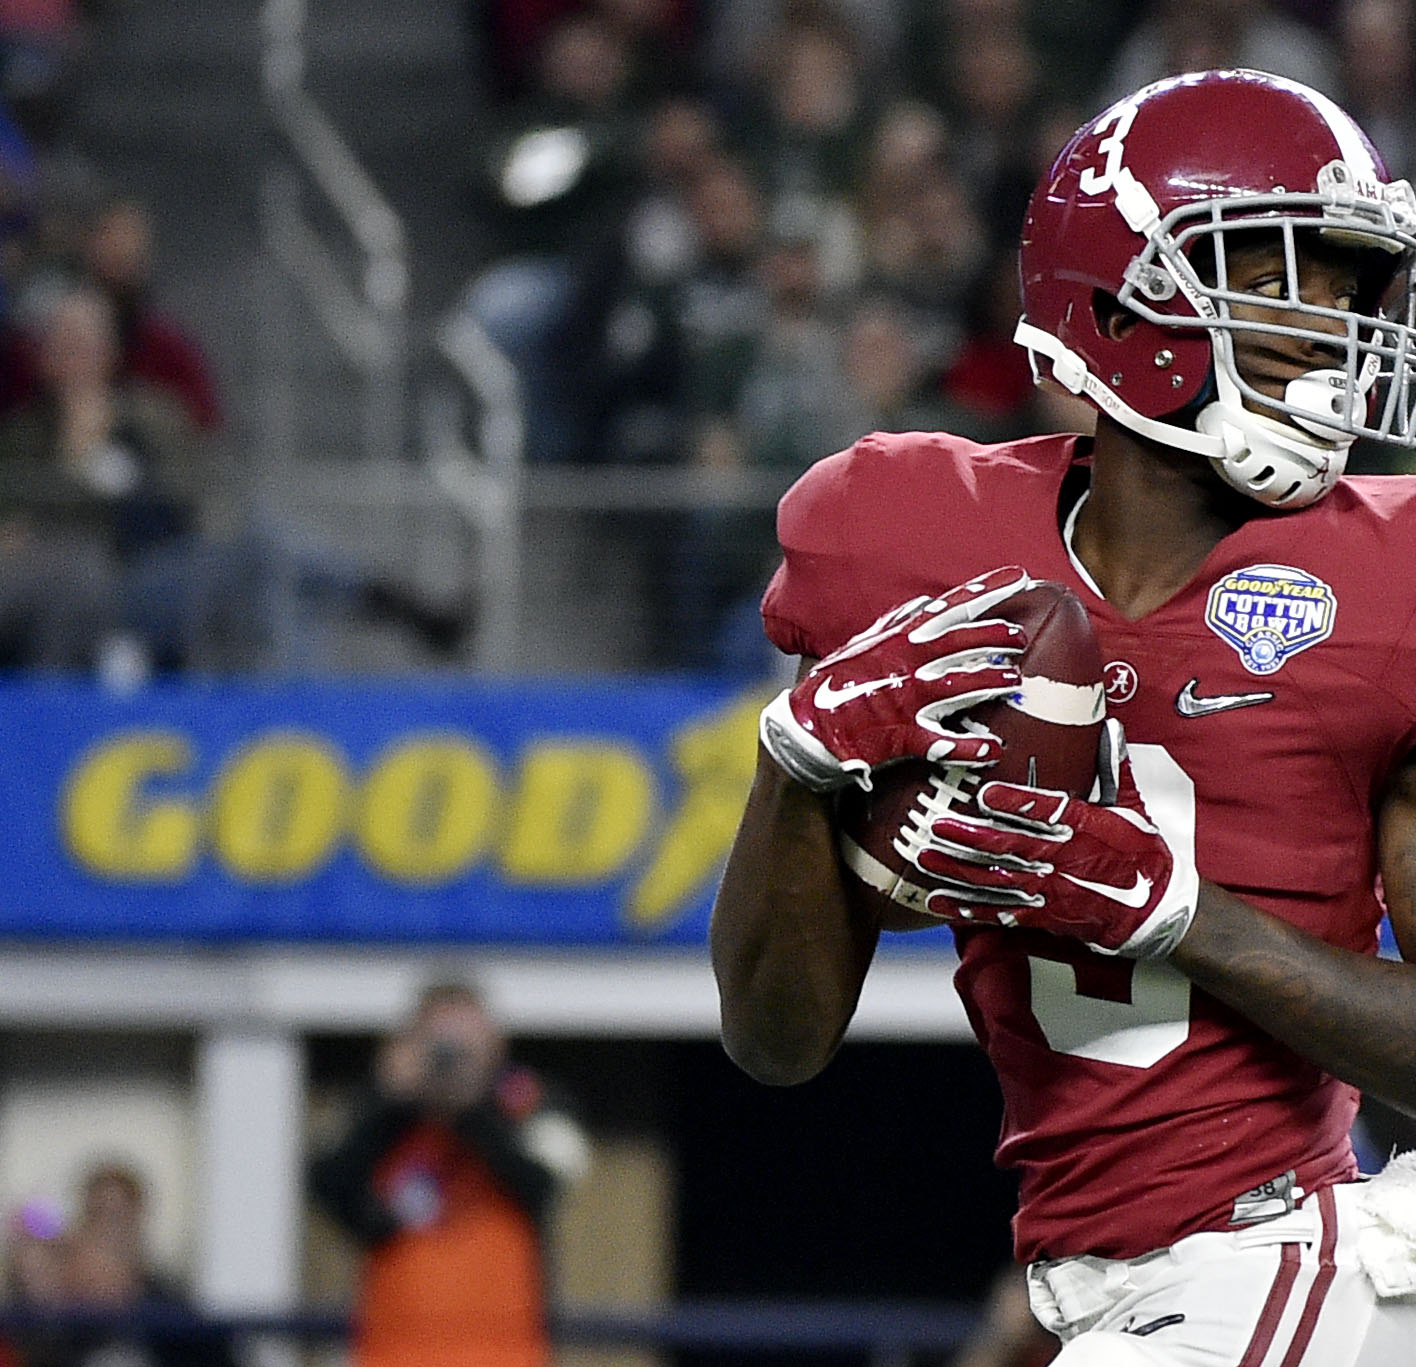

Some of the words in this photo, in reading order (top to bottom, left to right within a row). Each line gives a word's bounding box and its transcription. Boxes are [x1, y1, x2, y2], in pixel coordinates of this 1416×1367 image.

[1079, 104, 1138, 196] 3
[1225, 579, 1326, 599] GOODYEAR
[1217, 592, 1326, 634] COTTON
[1235, 613, 1302, 639] BOWL
